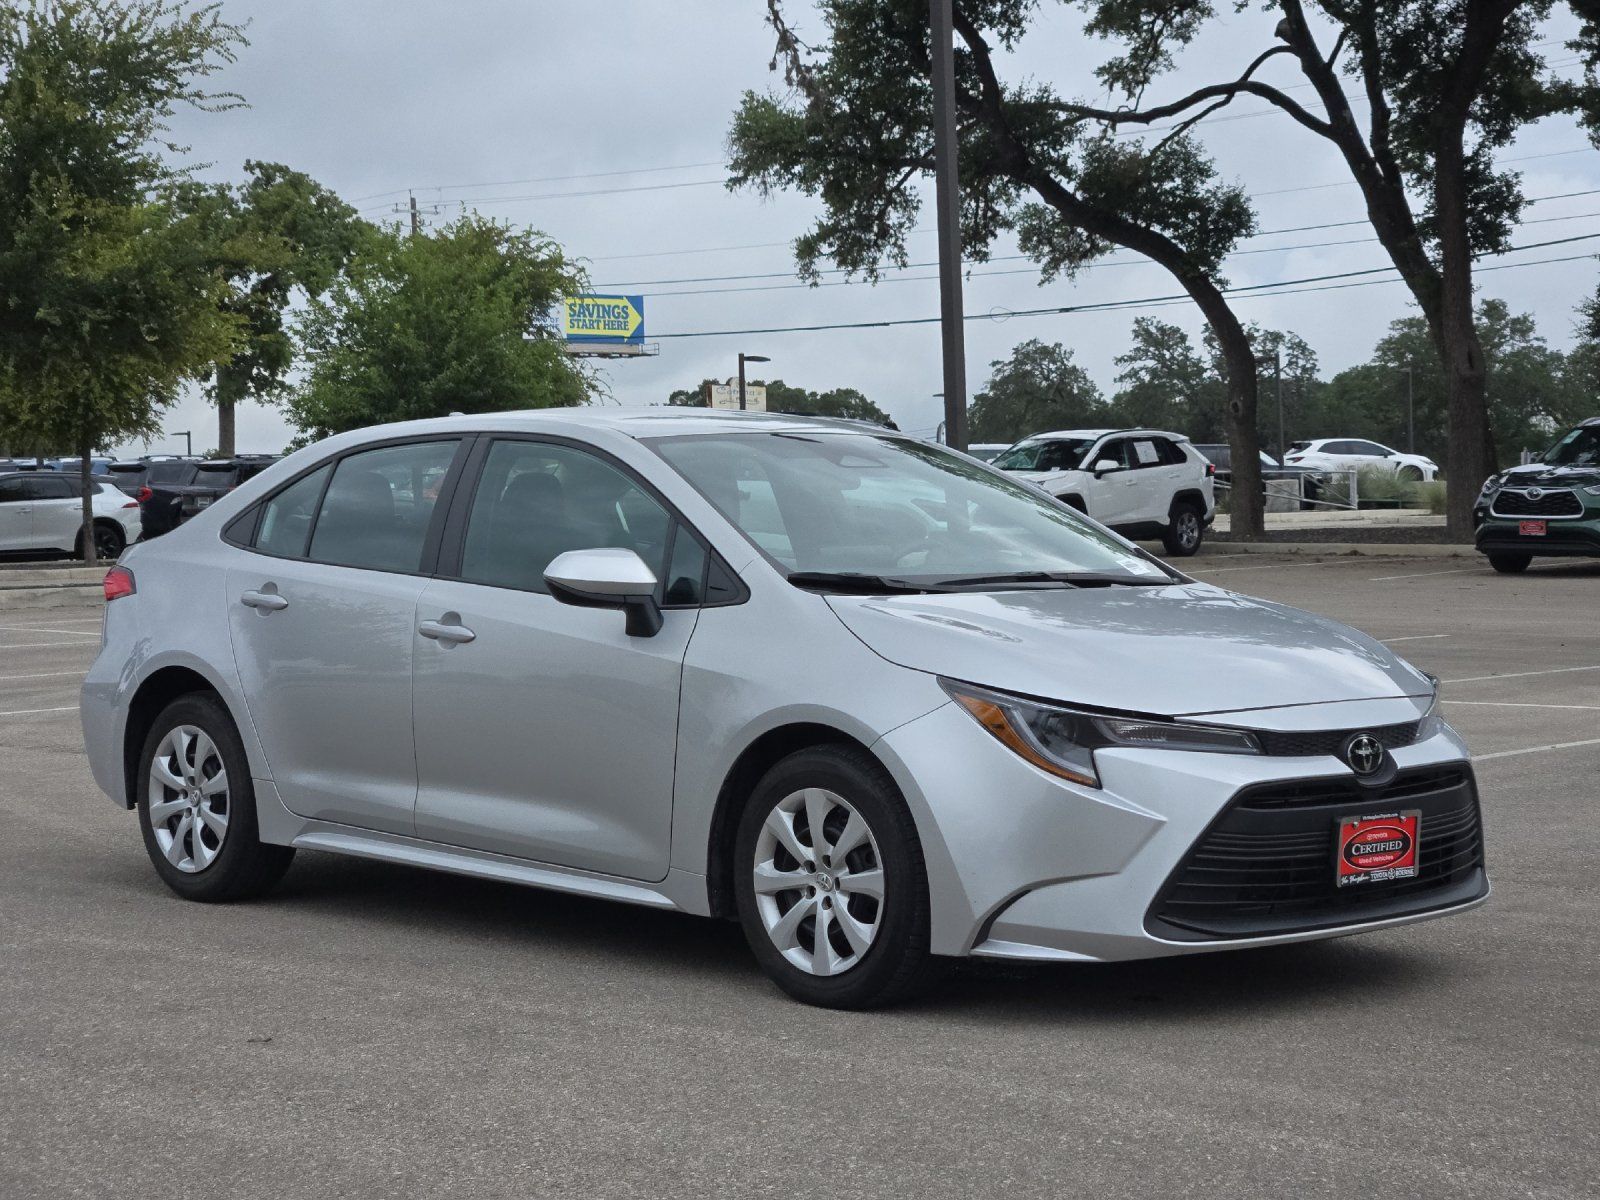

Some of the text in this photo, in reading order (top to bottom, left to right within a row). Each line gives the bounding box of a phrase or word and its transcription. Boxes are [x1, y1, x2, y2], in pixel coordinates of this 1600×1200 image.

[569, 303, 629, 319] SAVINGS
[570, 319, 602, 330] START
[603, 320, 629, 330] HERE
